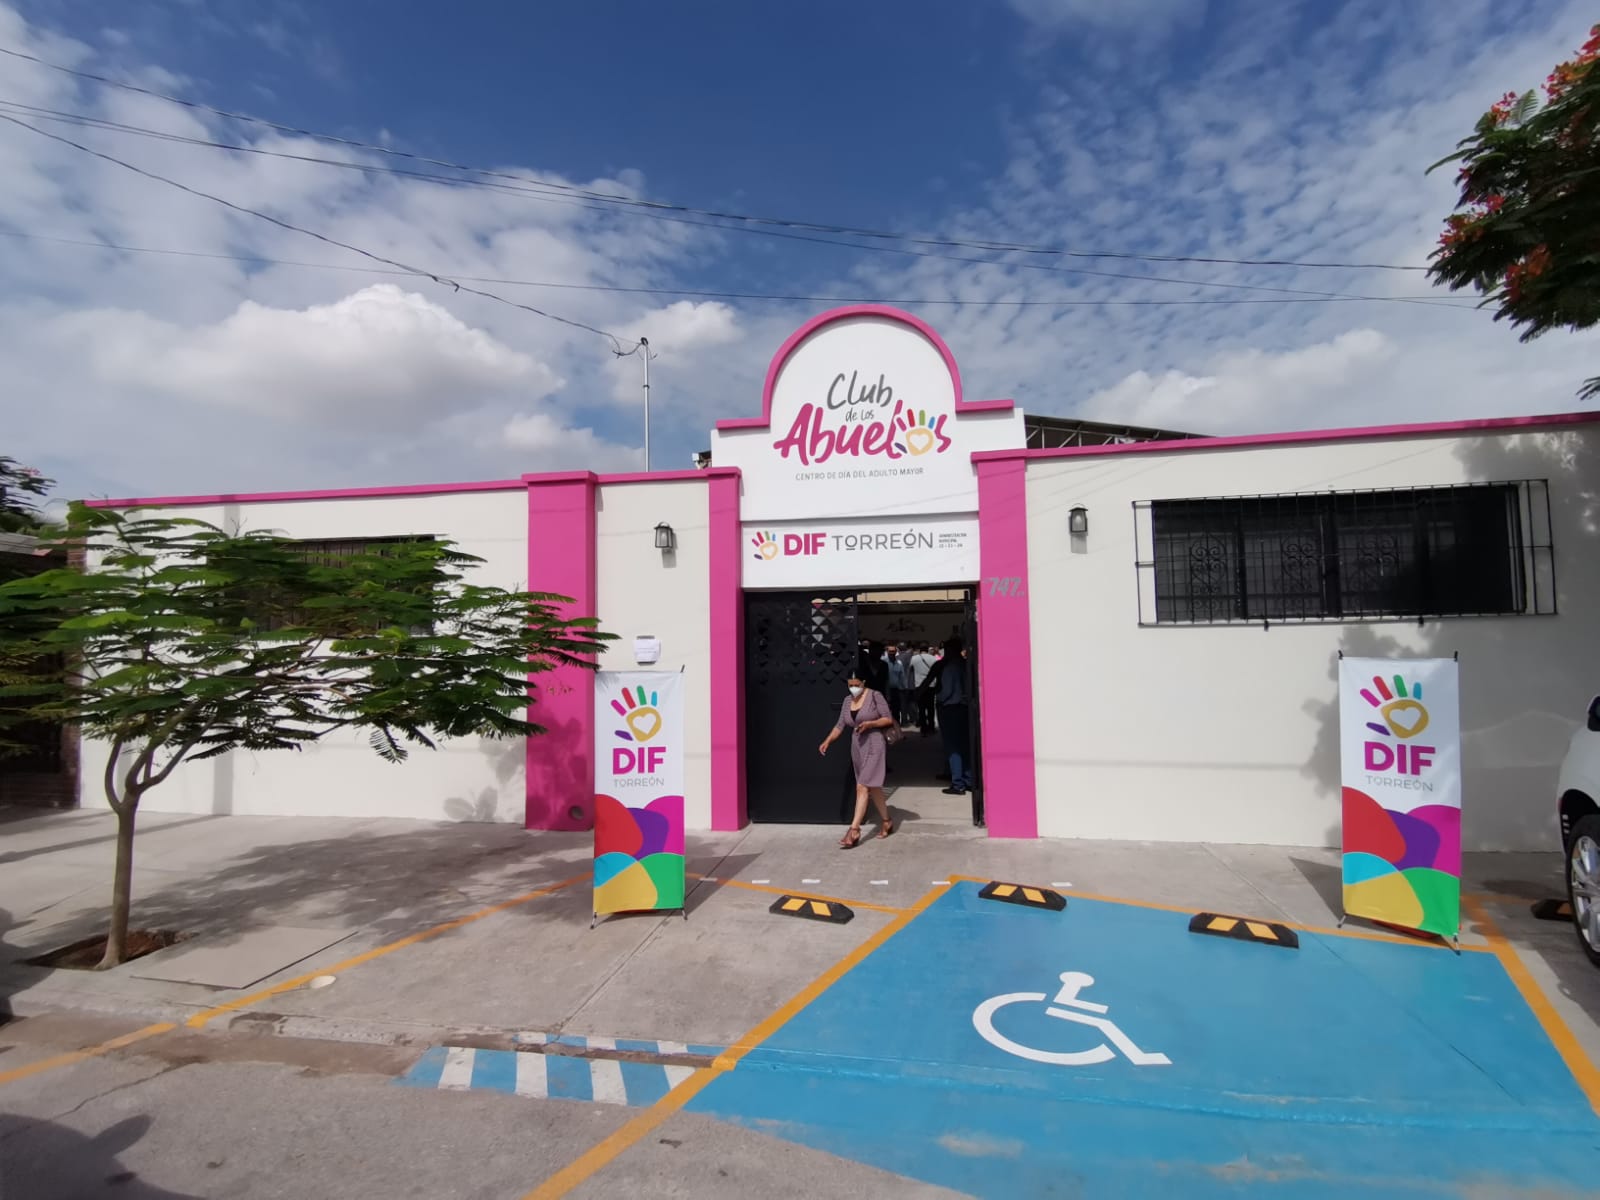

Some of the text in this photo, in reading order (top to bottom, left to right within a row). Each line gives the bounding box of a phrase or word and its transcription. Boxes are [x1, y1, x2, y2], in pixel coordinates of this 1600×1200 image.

[827, 370, 893, 410] Club
[845, 407, 875, 422] de los
[795, 472, 825, 480] CENTRO
[827, 471, 836, 479] DE
[853, 470, 866, 478] DEL
[869, 468, 897, 477] ADULTO
[900, 467, 923, 475] MAYOR
[784, 529, 933, 556] DIF TORREÓN
[989, 576, 1022, 597] 747
[612, 746, 667, 775] DIF
[1364, 741, 1436, 776] DIF
[1365, 775, 1434, 792] TORREÓN
